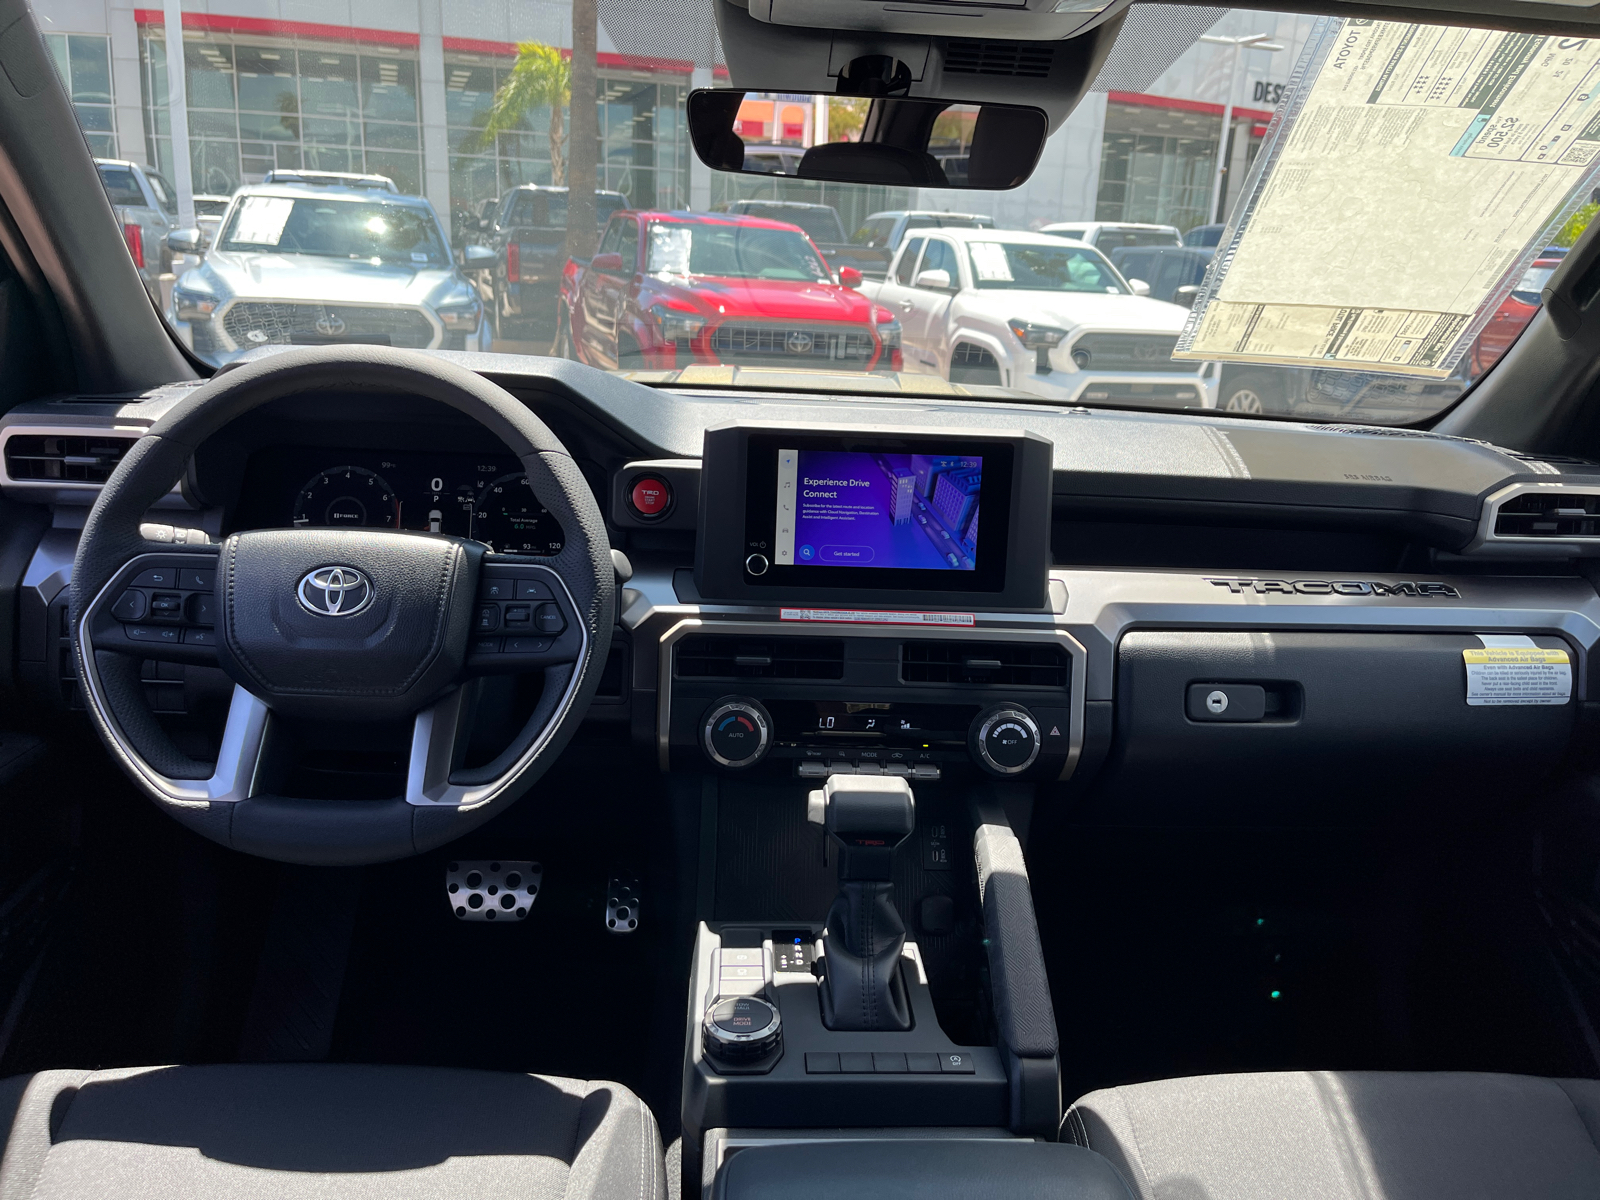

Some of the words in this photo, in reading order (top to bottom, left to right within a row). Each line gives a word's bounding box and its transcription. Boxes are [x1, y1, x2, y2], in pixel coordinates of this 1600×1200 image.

[368, 478, 374, 486] 5
[431, 477, 443, 492] 0
[804, 478, 848, 487] Experience
[849, 478, 870, 487] Drive
[803, 490, 838, 498] Connect
[1202, 578, 1462, 598] TACOMA
[819, 717, 834, 728] LO
